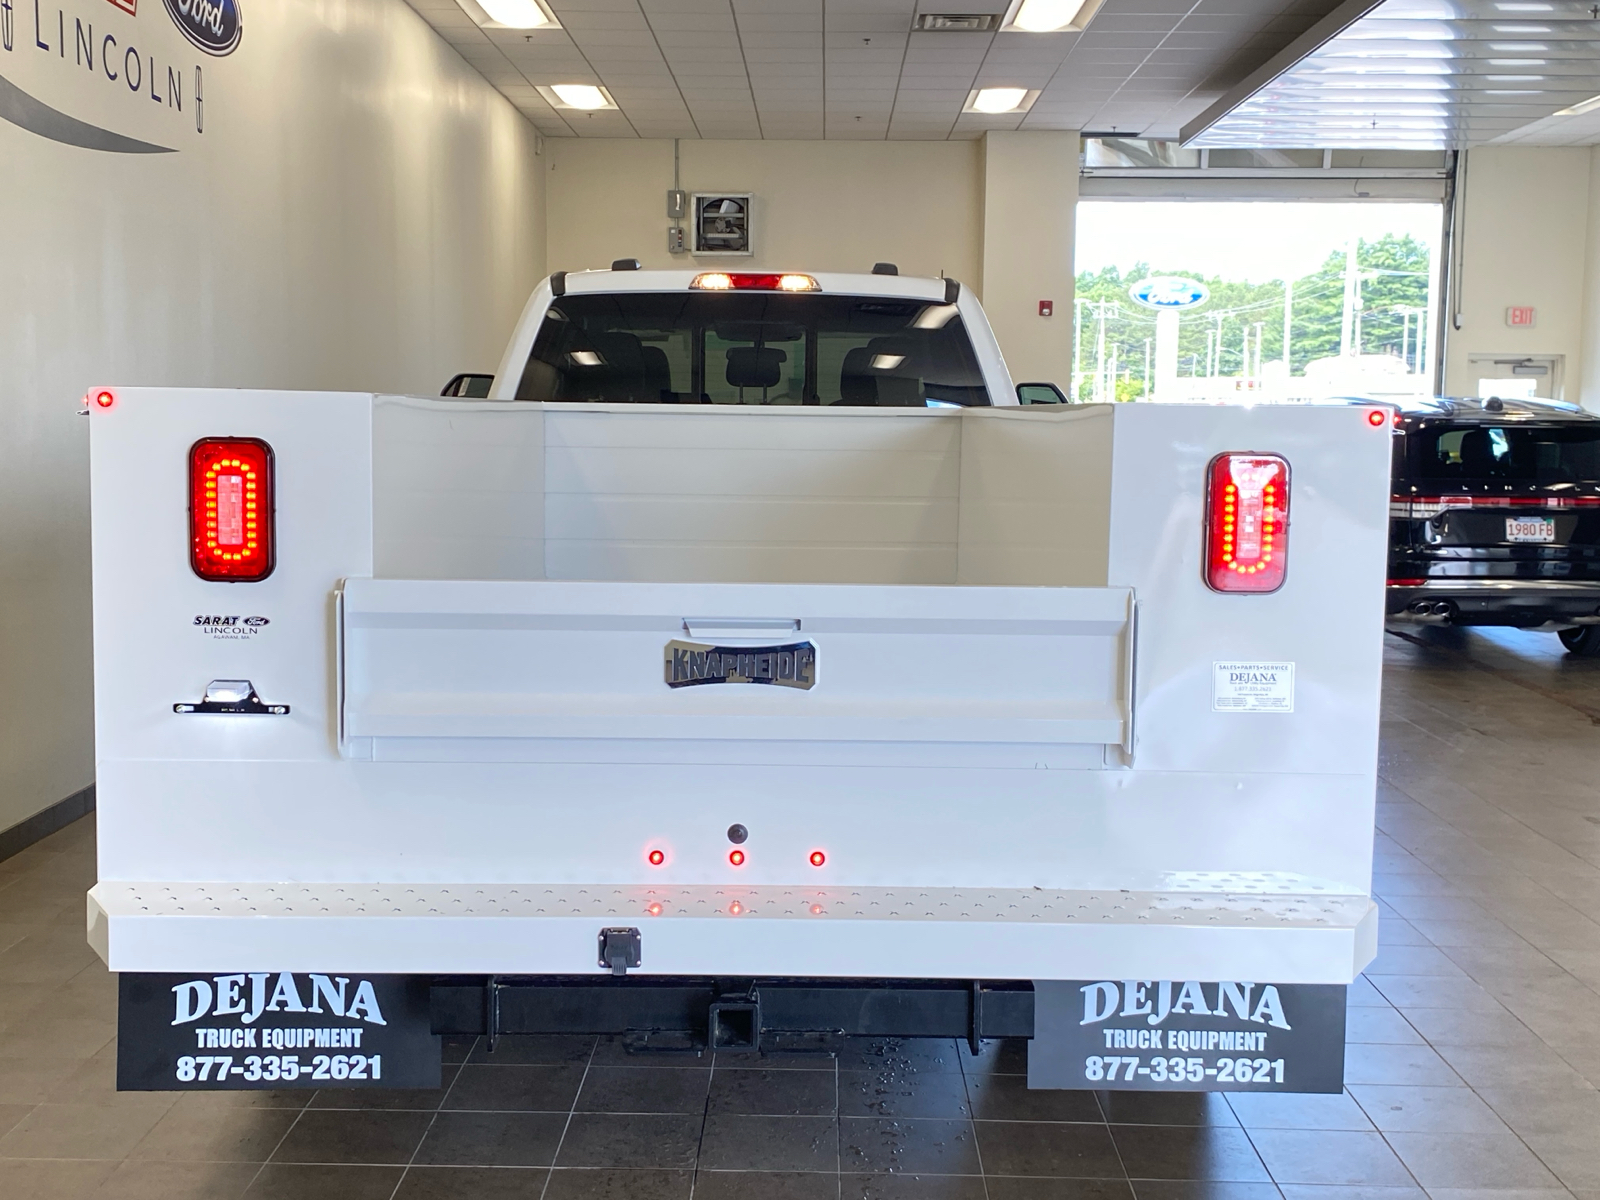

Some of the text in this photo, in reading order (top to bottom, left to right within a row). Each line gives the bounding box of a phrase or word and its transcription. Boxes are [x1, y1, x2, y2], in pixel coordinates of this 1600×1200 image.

[34, 0, 182, 112] LINCOLN
[1512, 307, 1534, 324] EXIT
[1508, 523, 1553, 537] 1980 FB
[193, 615, 239, 626] SARAT
[672, 647, 810, 682] KNAPHEIDE
[1229, 672, 1277, 684] DEJANA
[170, 972, 388, 1025] DEJANA
[1079, 980, 1292, 1030] DEJANA
[195, 1028, 364, 1050] TRUCK EQUIPMENT
[1103, 1029, 1268, 1052] TRUCK EQUIPMENT
[175, 1054, 382, 1082] 877-335-2621
[1084, 1056, 1286, 1083] 877-335-2621
